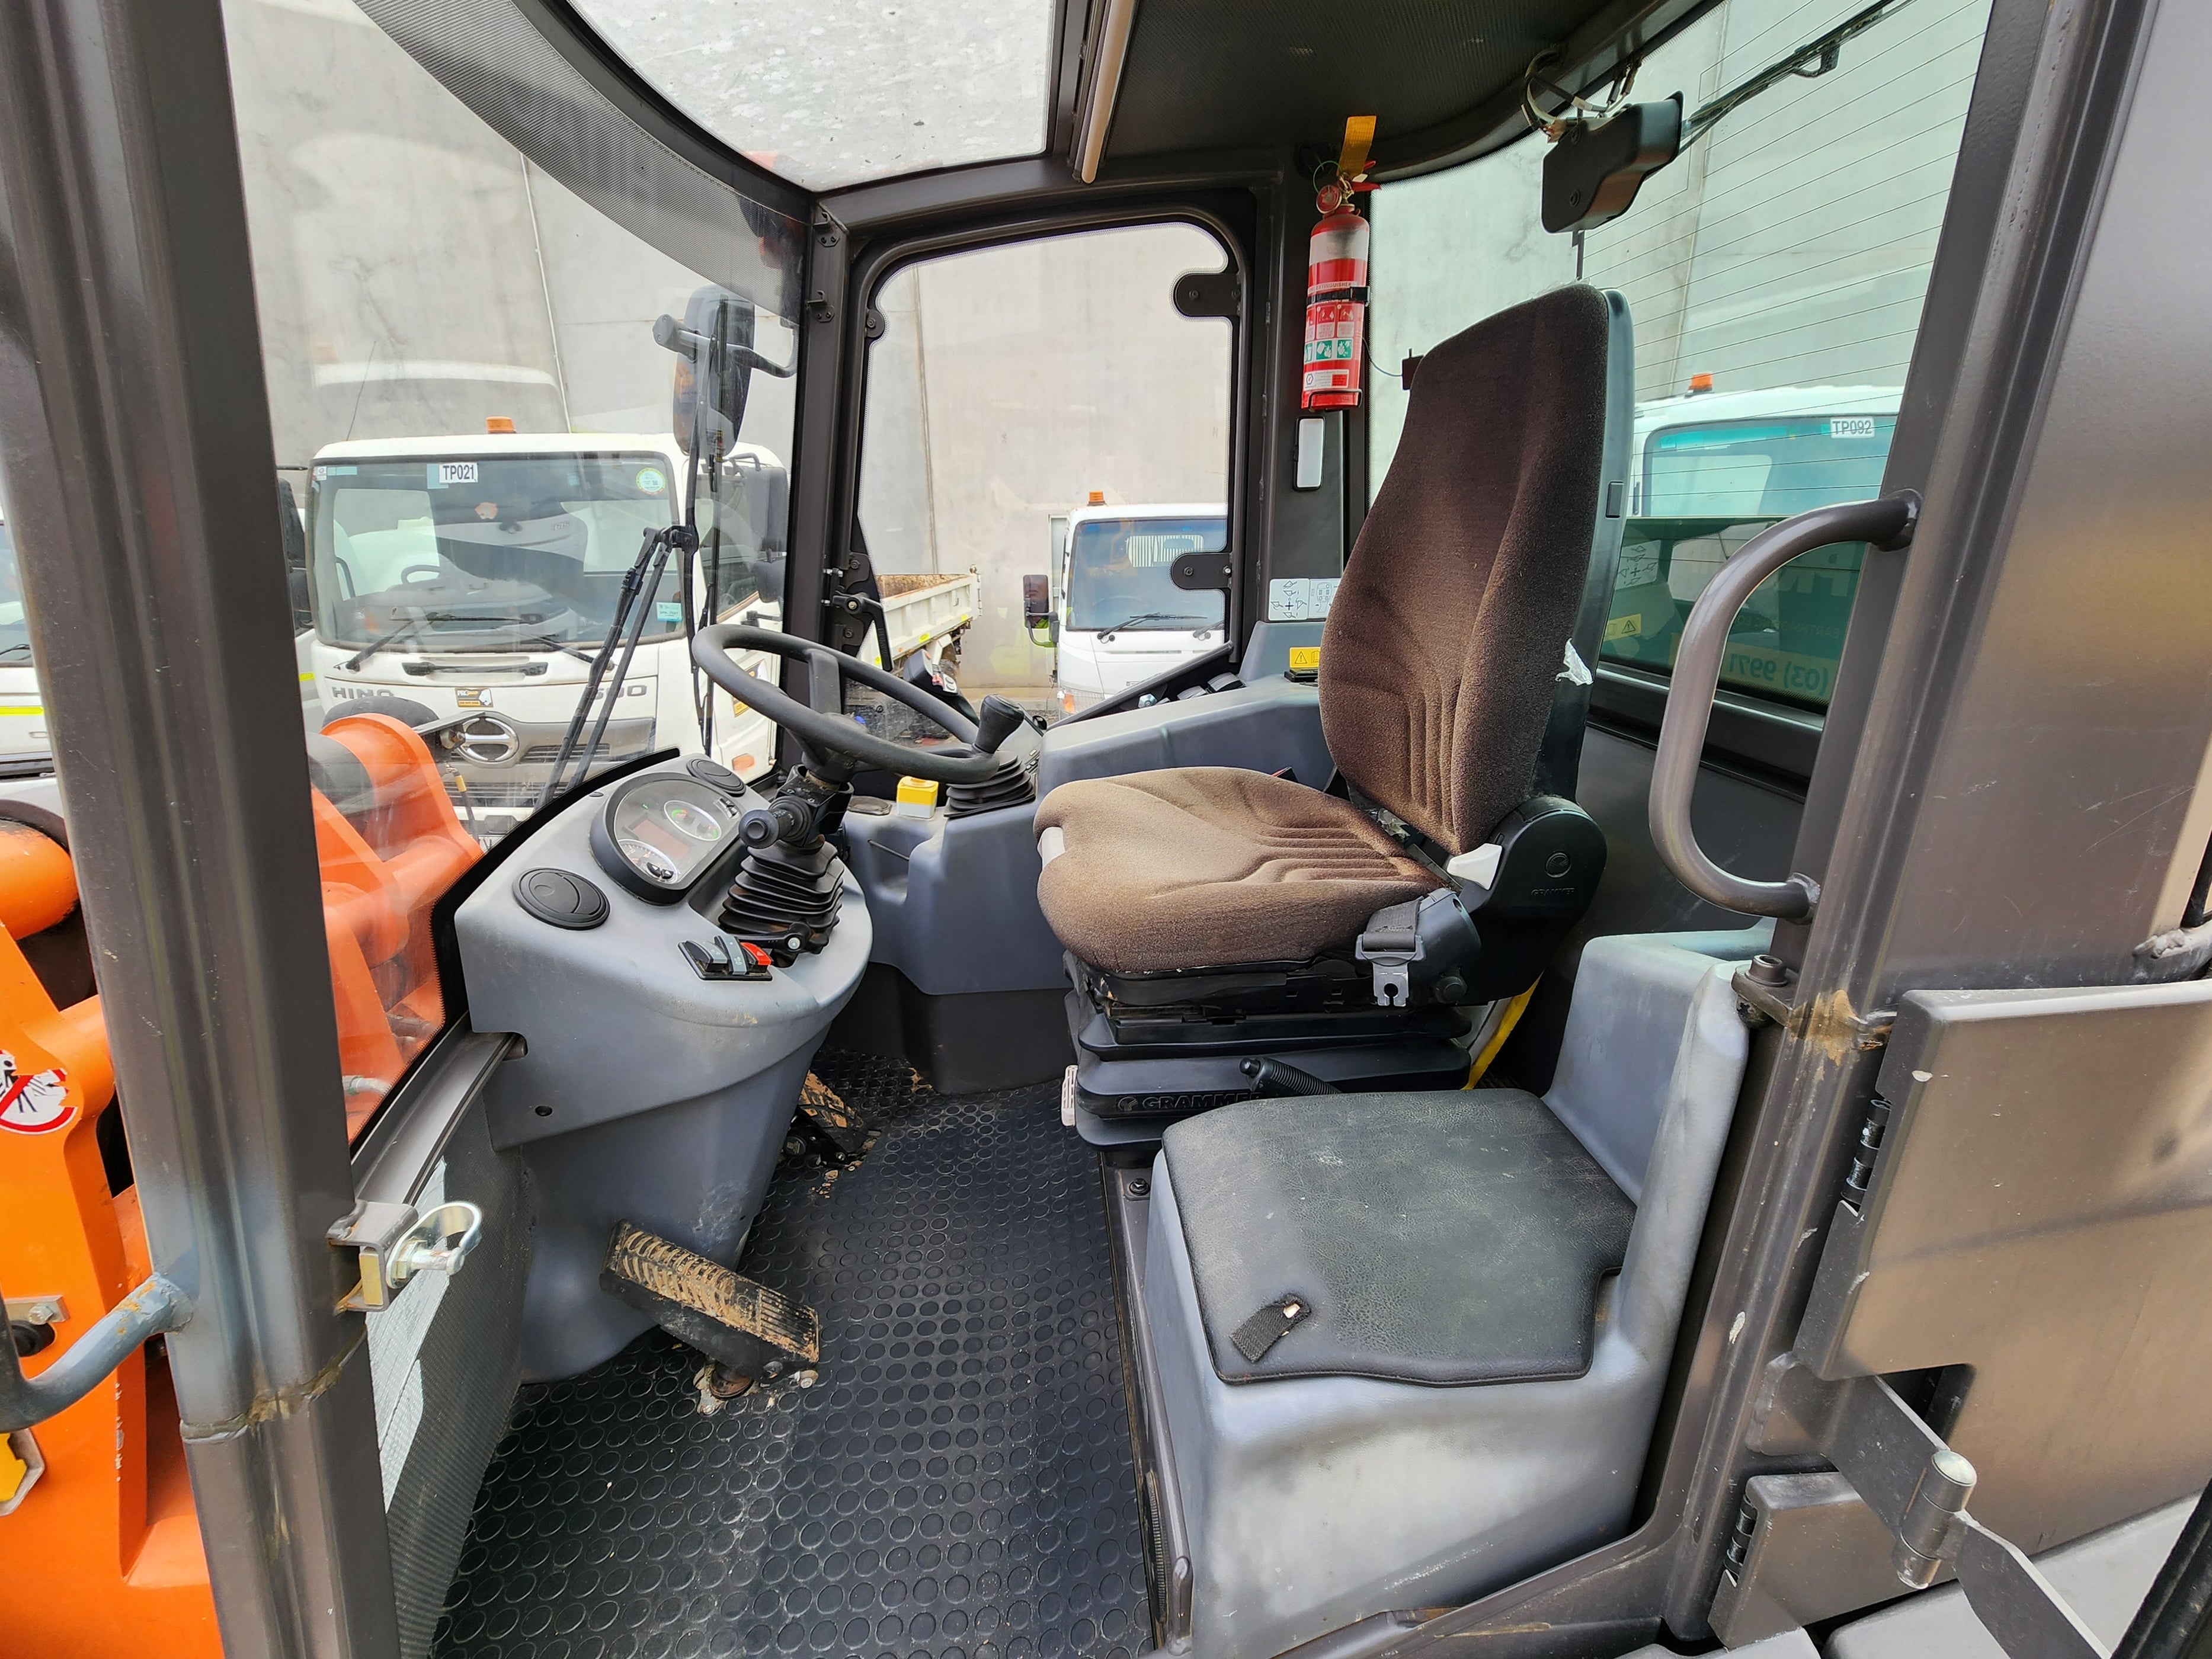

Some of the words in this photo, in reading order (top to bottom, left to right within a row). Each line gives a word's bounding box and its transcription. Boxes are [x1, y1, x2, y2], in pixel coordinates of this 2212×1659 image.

[1832, 420, 1872, 435] TP092
[443, 465, 474, 480] TP021
[332, 687, 394, 699] HINO
